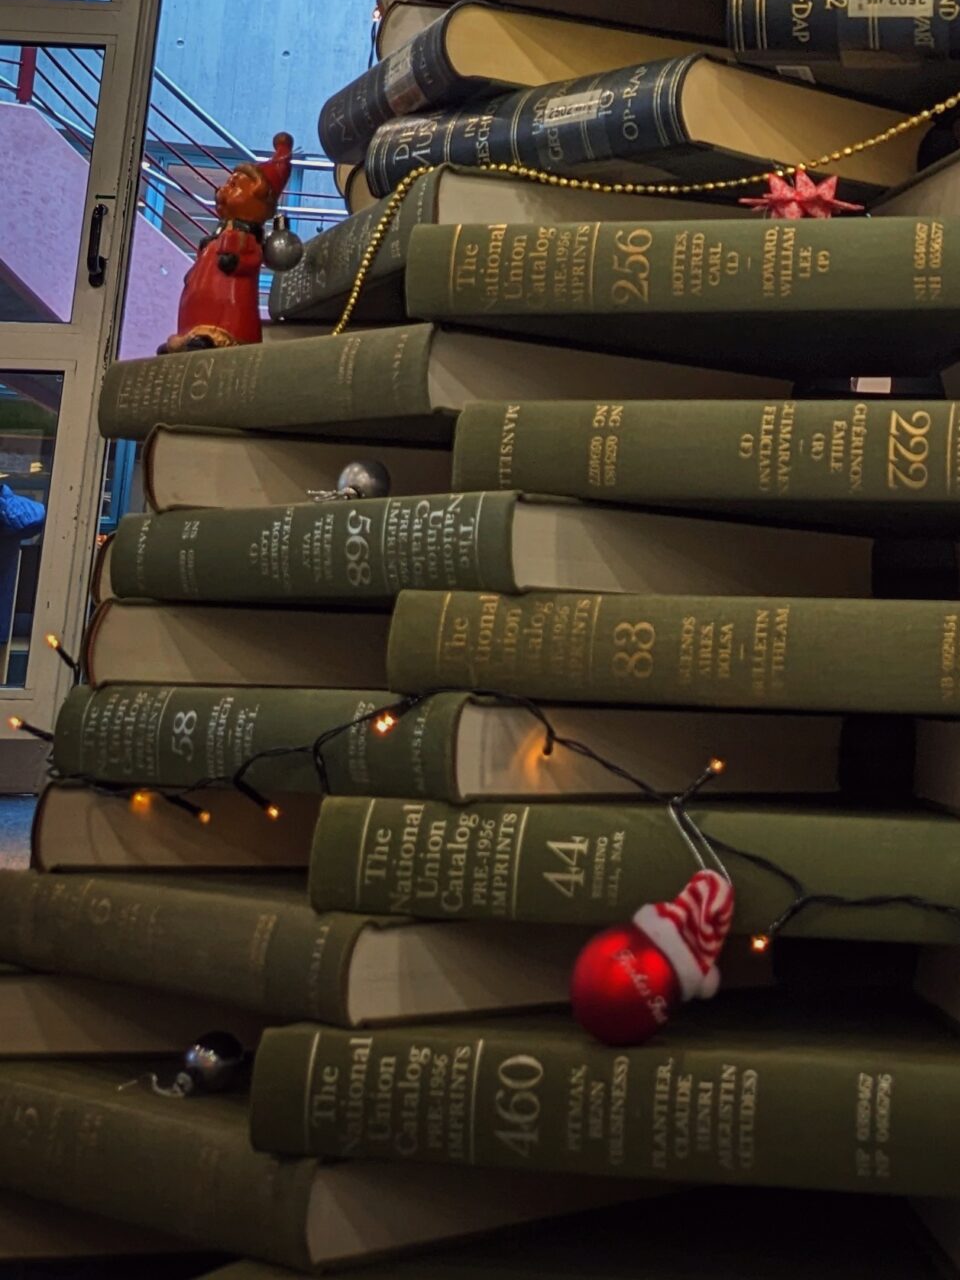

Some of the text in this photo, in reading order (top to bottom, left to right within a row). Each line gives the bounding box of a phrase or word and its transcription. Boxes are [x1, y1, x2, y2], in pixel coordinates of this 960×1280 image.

[456, 243, 479, 292] The
[504, 234, 527, 300] Union
[612, 228, 653, 305] 256
[690, 232, 705, 296] ALFRED
[709, 242, 722, 286] CARL
[762, 226, 780, 298] HOWARD,
[780, 227, 796, 298] WILLIAM
[800, 246, 813, 278] LEE
[500, 405, 520, 487] MANSELL
[888, 410, 931, 490] 222
[345, 509, 372, 587] 568
[458, 516, 475, 570] The
[718, 622, 734, 680] BOLSA
[365, 827, 392, 885] The
[390, 803, 424, 914] National
[416, 819, 446, 899] Union
[441, 812, 479, 912] Catalog
[473, 819, 496, 905] PRE-1956
[492, 812, 517, 914] IMPRINTS
[543, 835, 589, 898] 44
[311, 1065, 339, 1126] The
[369, 1056, 397, 1141] Union
[396, 1045, 431, 1156] Catalog
[427, 1054, 448, 1148] PRE-1956
[495, 1055, 544, 1158] 460
[589, 1080, 605, 1139] BENN
[676, 1074, 693, 1159] CLAUDE
[697, 1081, 714, 1152] HENRI
[718, 1064, 738, 1170] AUGUSTIN
